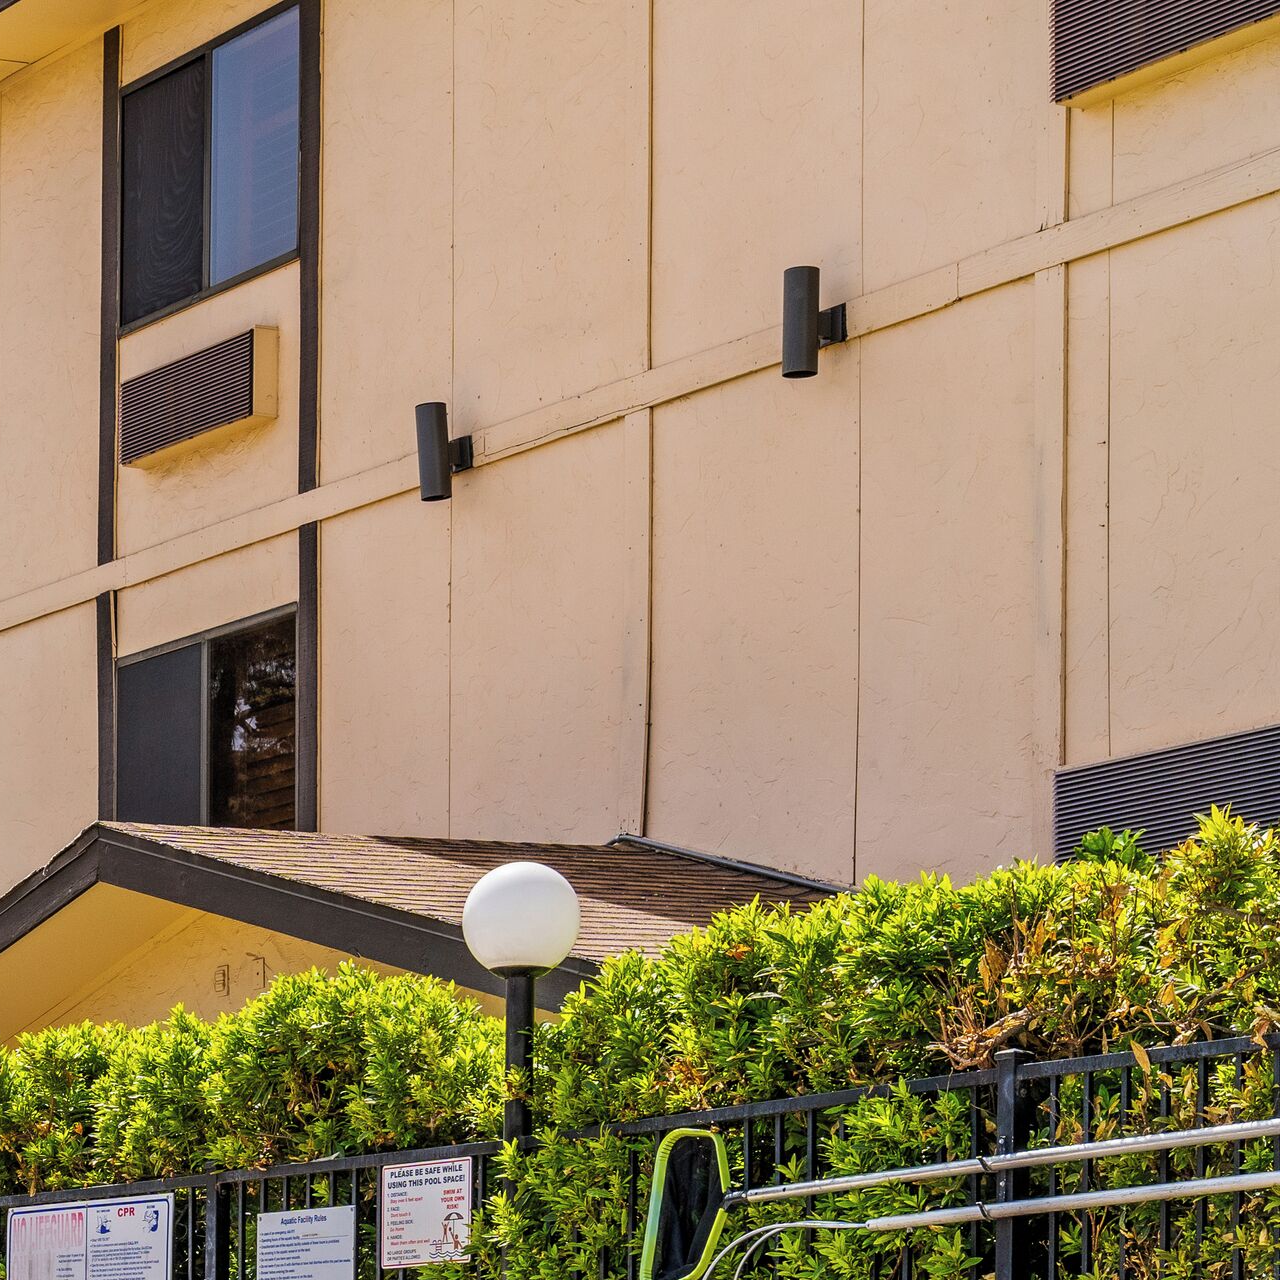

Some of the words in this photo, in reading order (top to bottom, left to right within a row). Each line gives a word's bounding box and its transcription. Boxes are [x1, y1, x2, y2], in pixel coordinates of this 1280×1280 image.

[390, 1169, 414, 1178] PLEASE
[415, 1168, 424, 1176] BE
[424, 1166, 440, 1174] SAFE
[442, 1164, 463, 1172] WHILE
[388, 1181, 407, 1190] USING
[424, 1178, 442, 1186] POOL
[443, 1174, 466, 1184] SPACE!
[118, 1207, 135, 1217] CPR
[280, 1217, 297, 1225] Aquatic
[298, 1216, 314, 1224] Facility
[14, 1217, 26, 1252] NO
